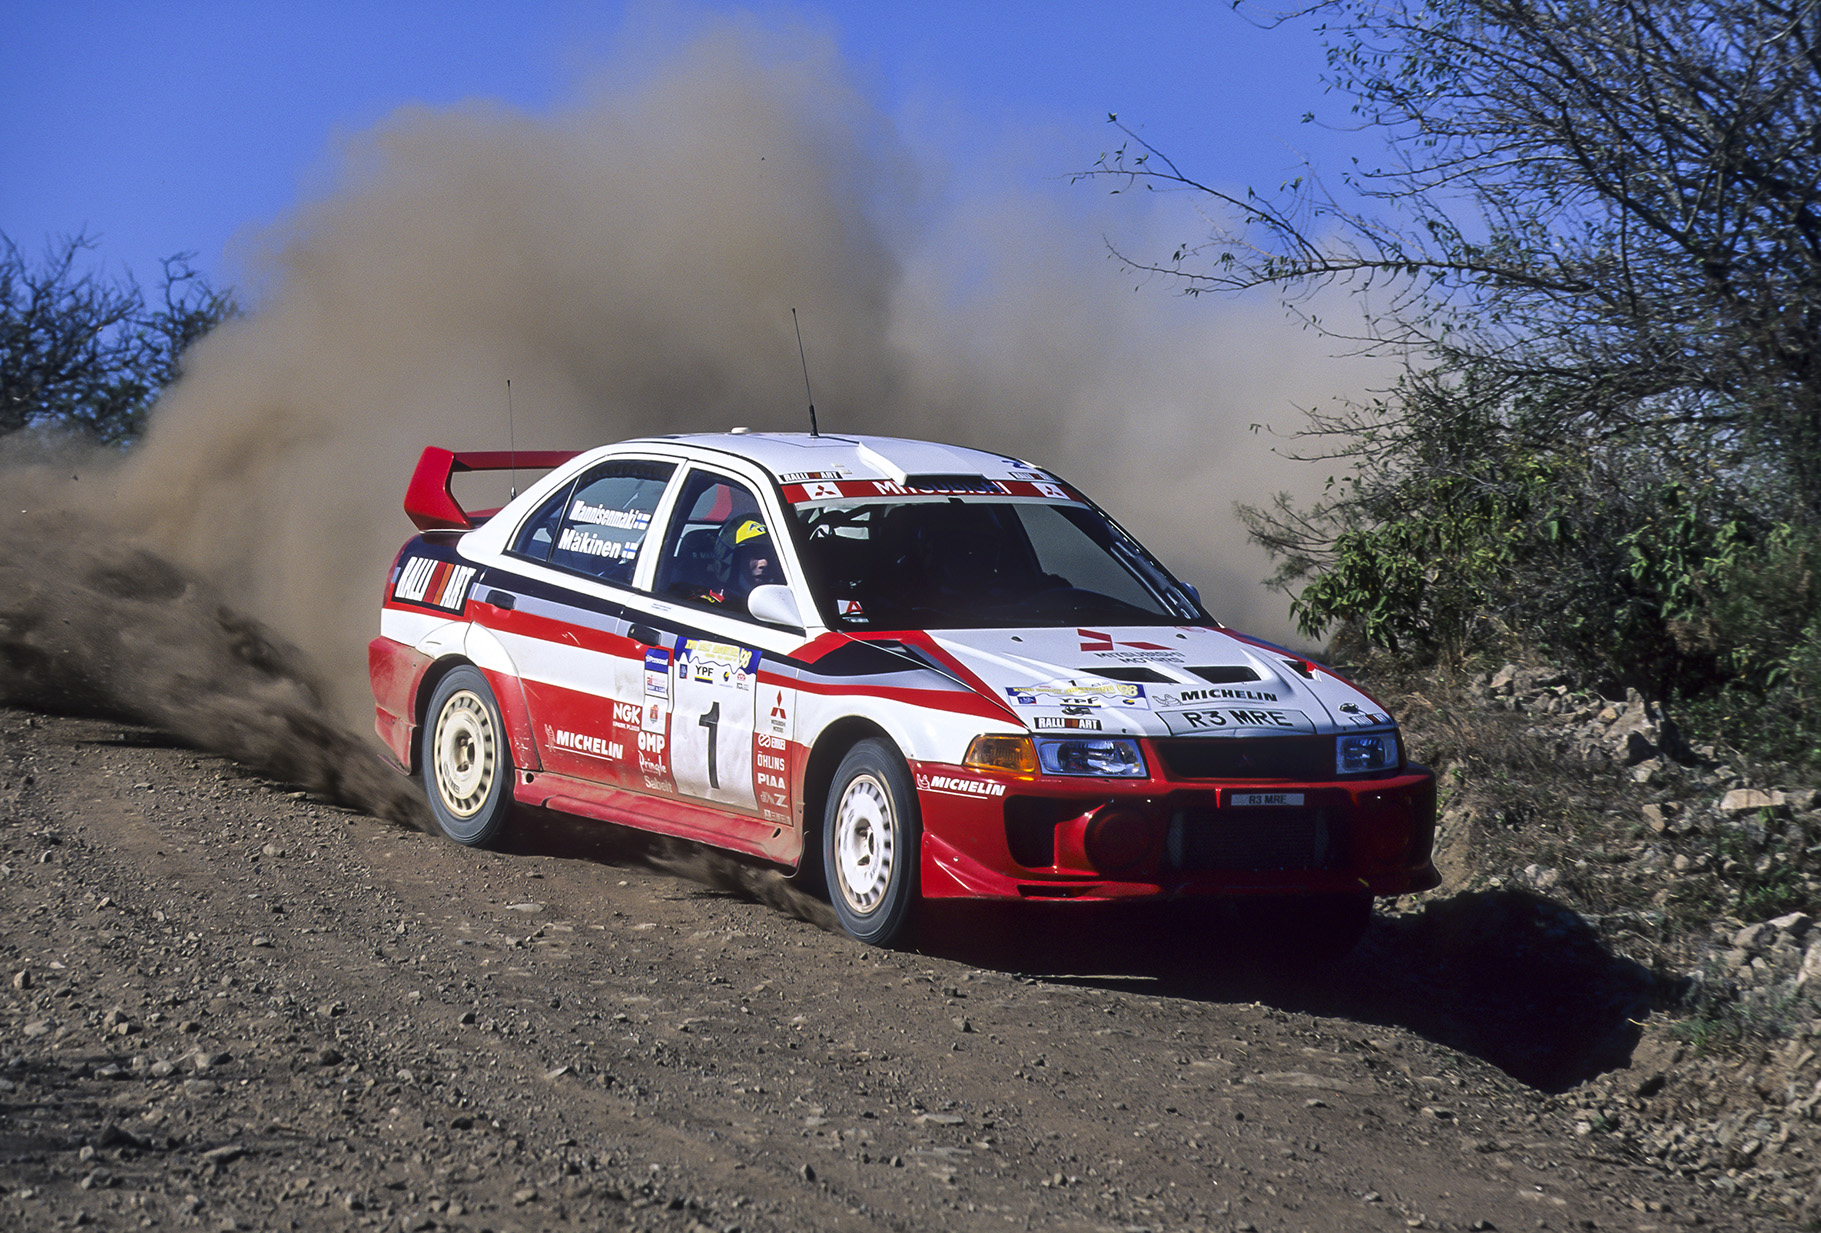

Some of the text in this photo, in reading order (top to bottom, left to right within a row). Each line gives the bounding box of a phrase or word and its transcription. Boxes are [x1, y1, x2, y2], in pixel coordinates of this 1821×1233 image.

[784, 473, 809, 481] RALLI
[558, 528, 622, 559] Mäkinen
[395, 556, 477, 611] RALLI ART
[695, 665, 714, 677] YPF
[1180, 688, 1278, 702] MICHELIN
[613, 702, 641, 725] NGK
[1181, 709, 1293, 728] R3 MRE
[1038, 718, 1098, 730] RALLI ART
[556, 729, 624, 760] MICHELIN
[637, 731, 665, 753] OMP
[698, 701, 720, 790] 1
[637, 749, 667, 776] Pringle
[643, 775, 673, 793] Sabelt
[757, 772, 786, 790] PIAA
[930, 775, 1006, 797] MICHELIN
[1248, 794, 1288, 805] R3 MRE
